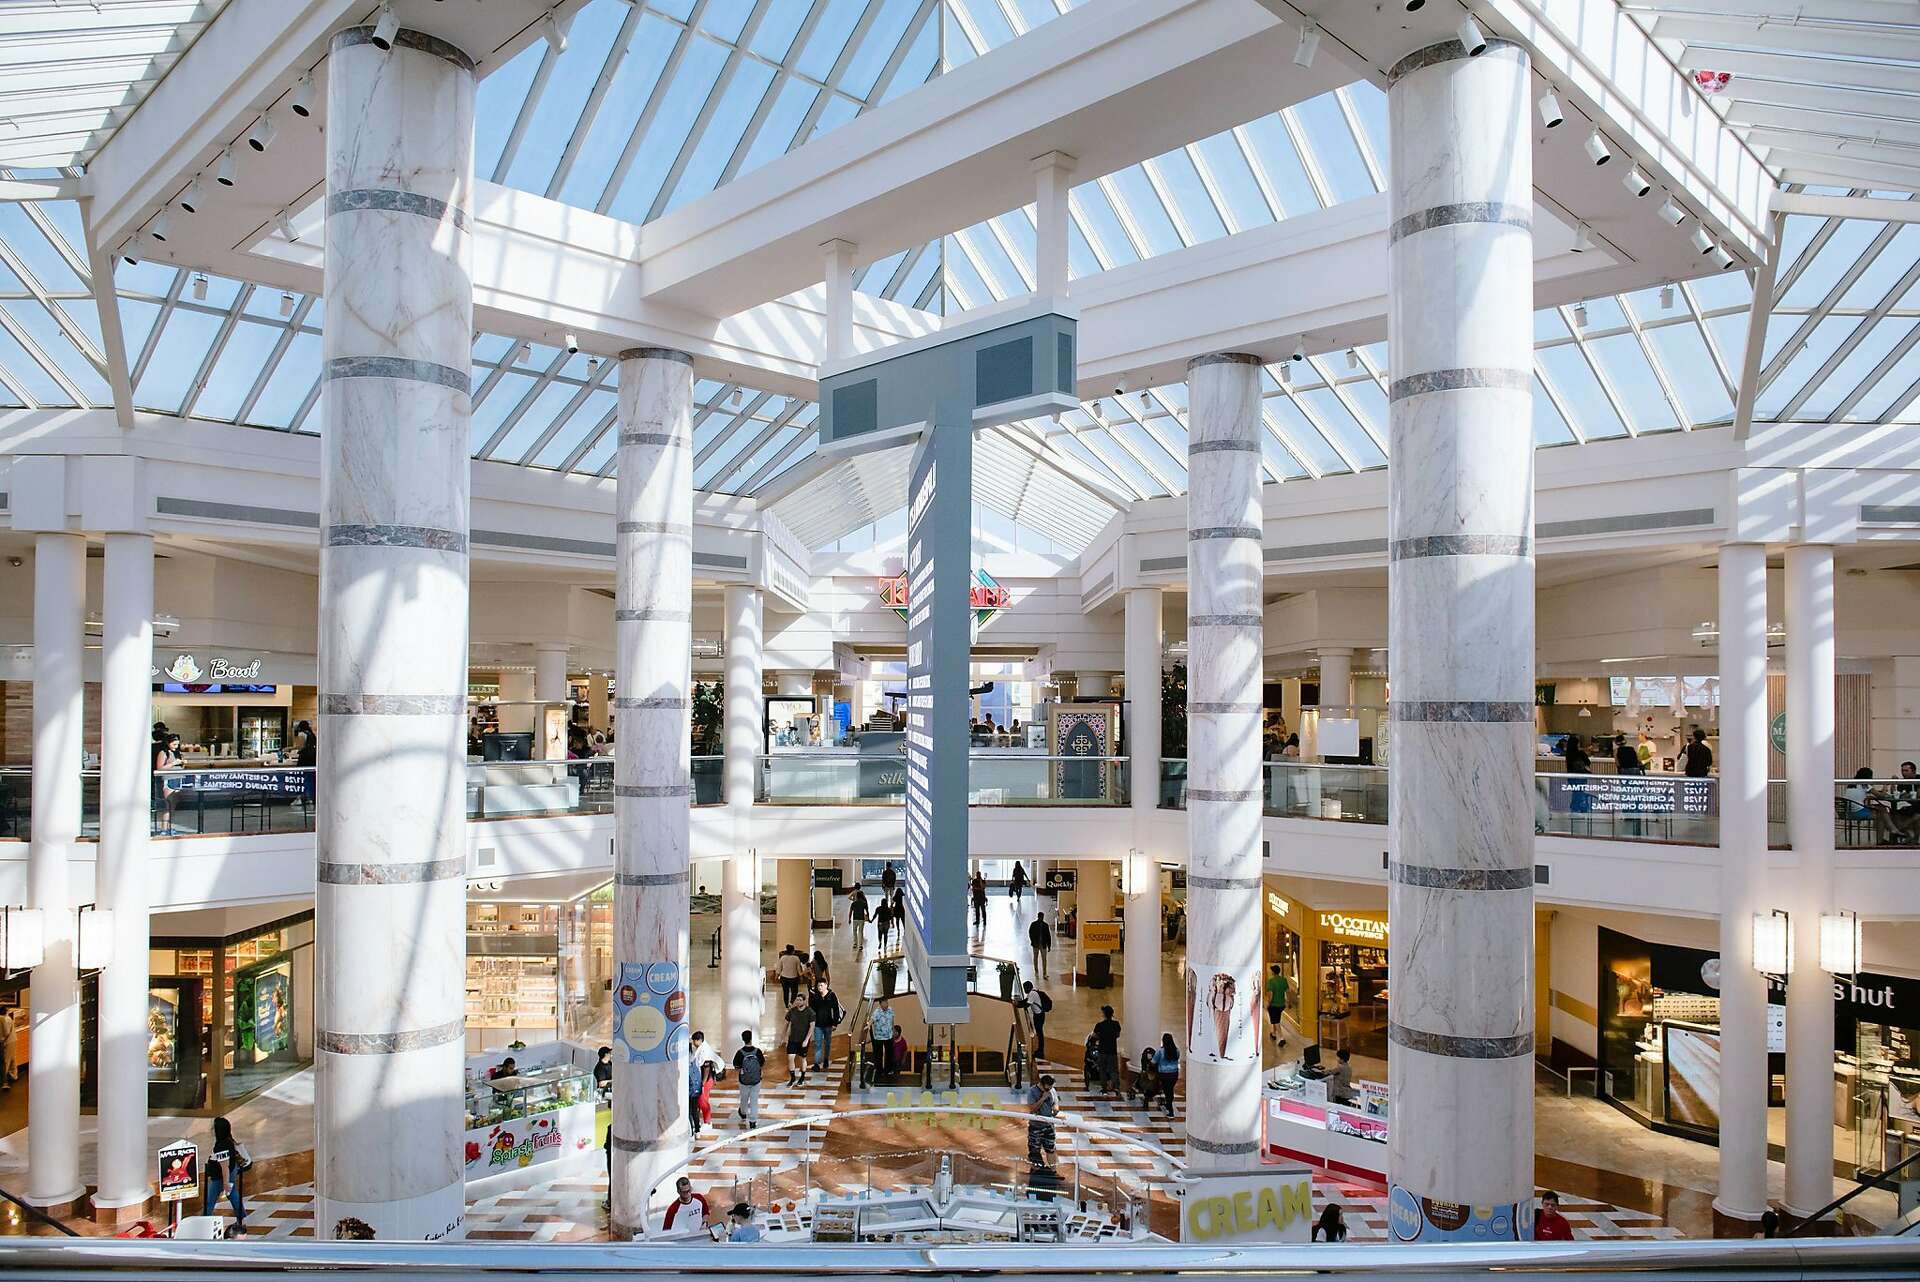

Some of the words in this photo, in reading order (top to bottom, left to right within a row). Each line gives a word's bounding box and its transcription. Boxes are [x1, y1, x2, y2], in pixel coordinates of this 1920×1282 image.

[210, 659, 261, 679] Bowl
[879, 773, 904, 785] Silk
[1046, 881, 1073, 889] Quickly
[1851, 980, 1895, 1009] hut
[492, 1138, 534, 1165] Splash
[1187, 1181, 1313, 1239] CREAM
